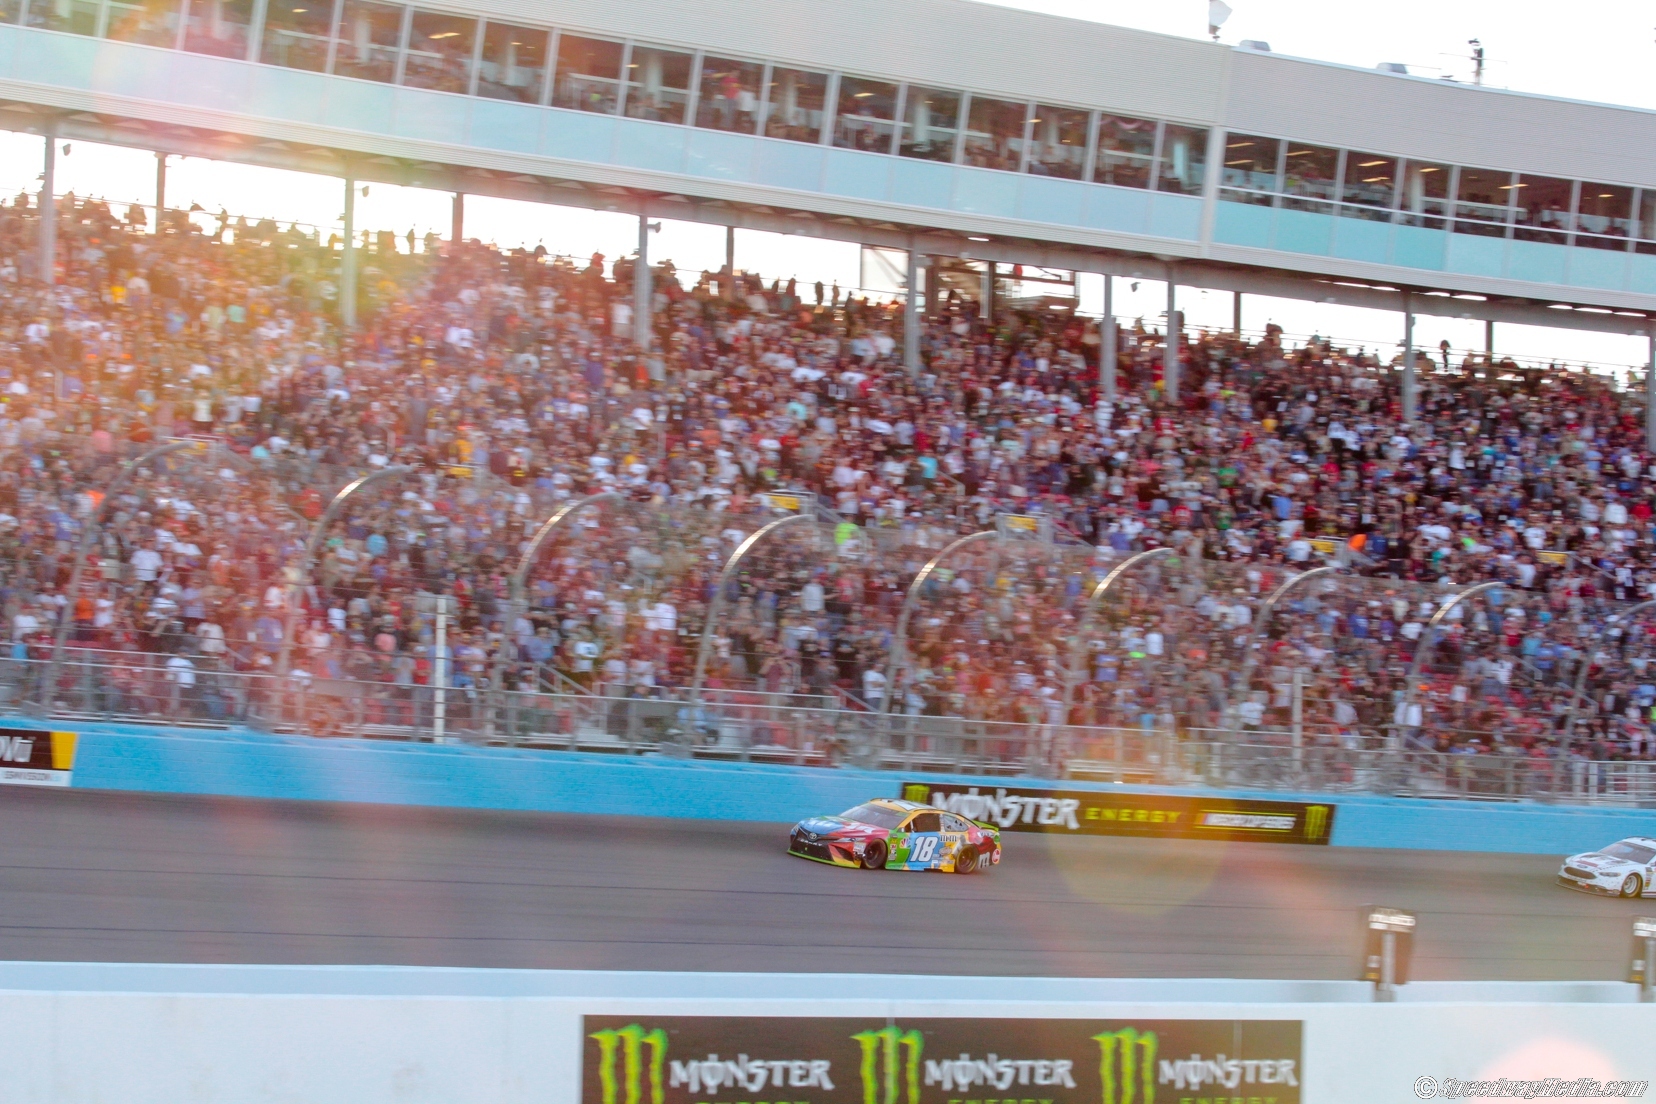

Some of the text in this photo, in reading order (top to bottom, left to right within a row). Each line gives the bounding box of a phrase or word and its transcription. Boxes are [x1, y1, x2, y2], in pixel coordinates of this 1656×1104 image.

[932, 787, 1081, 830] MONSTER
[1084, 807, 1183, 823] ENERGY
[910, 836, 938, 862] 18
[670, 1053, 835, 1094] MONSTER
[924, 1053, 1078, 1092] MONSTER
[1158, 1053, 1299, 1091] MONSTER
